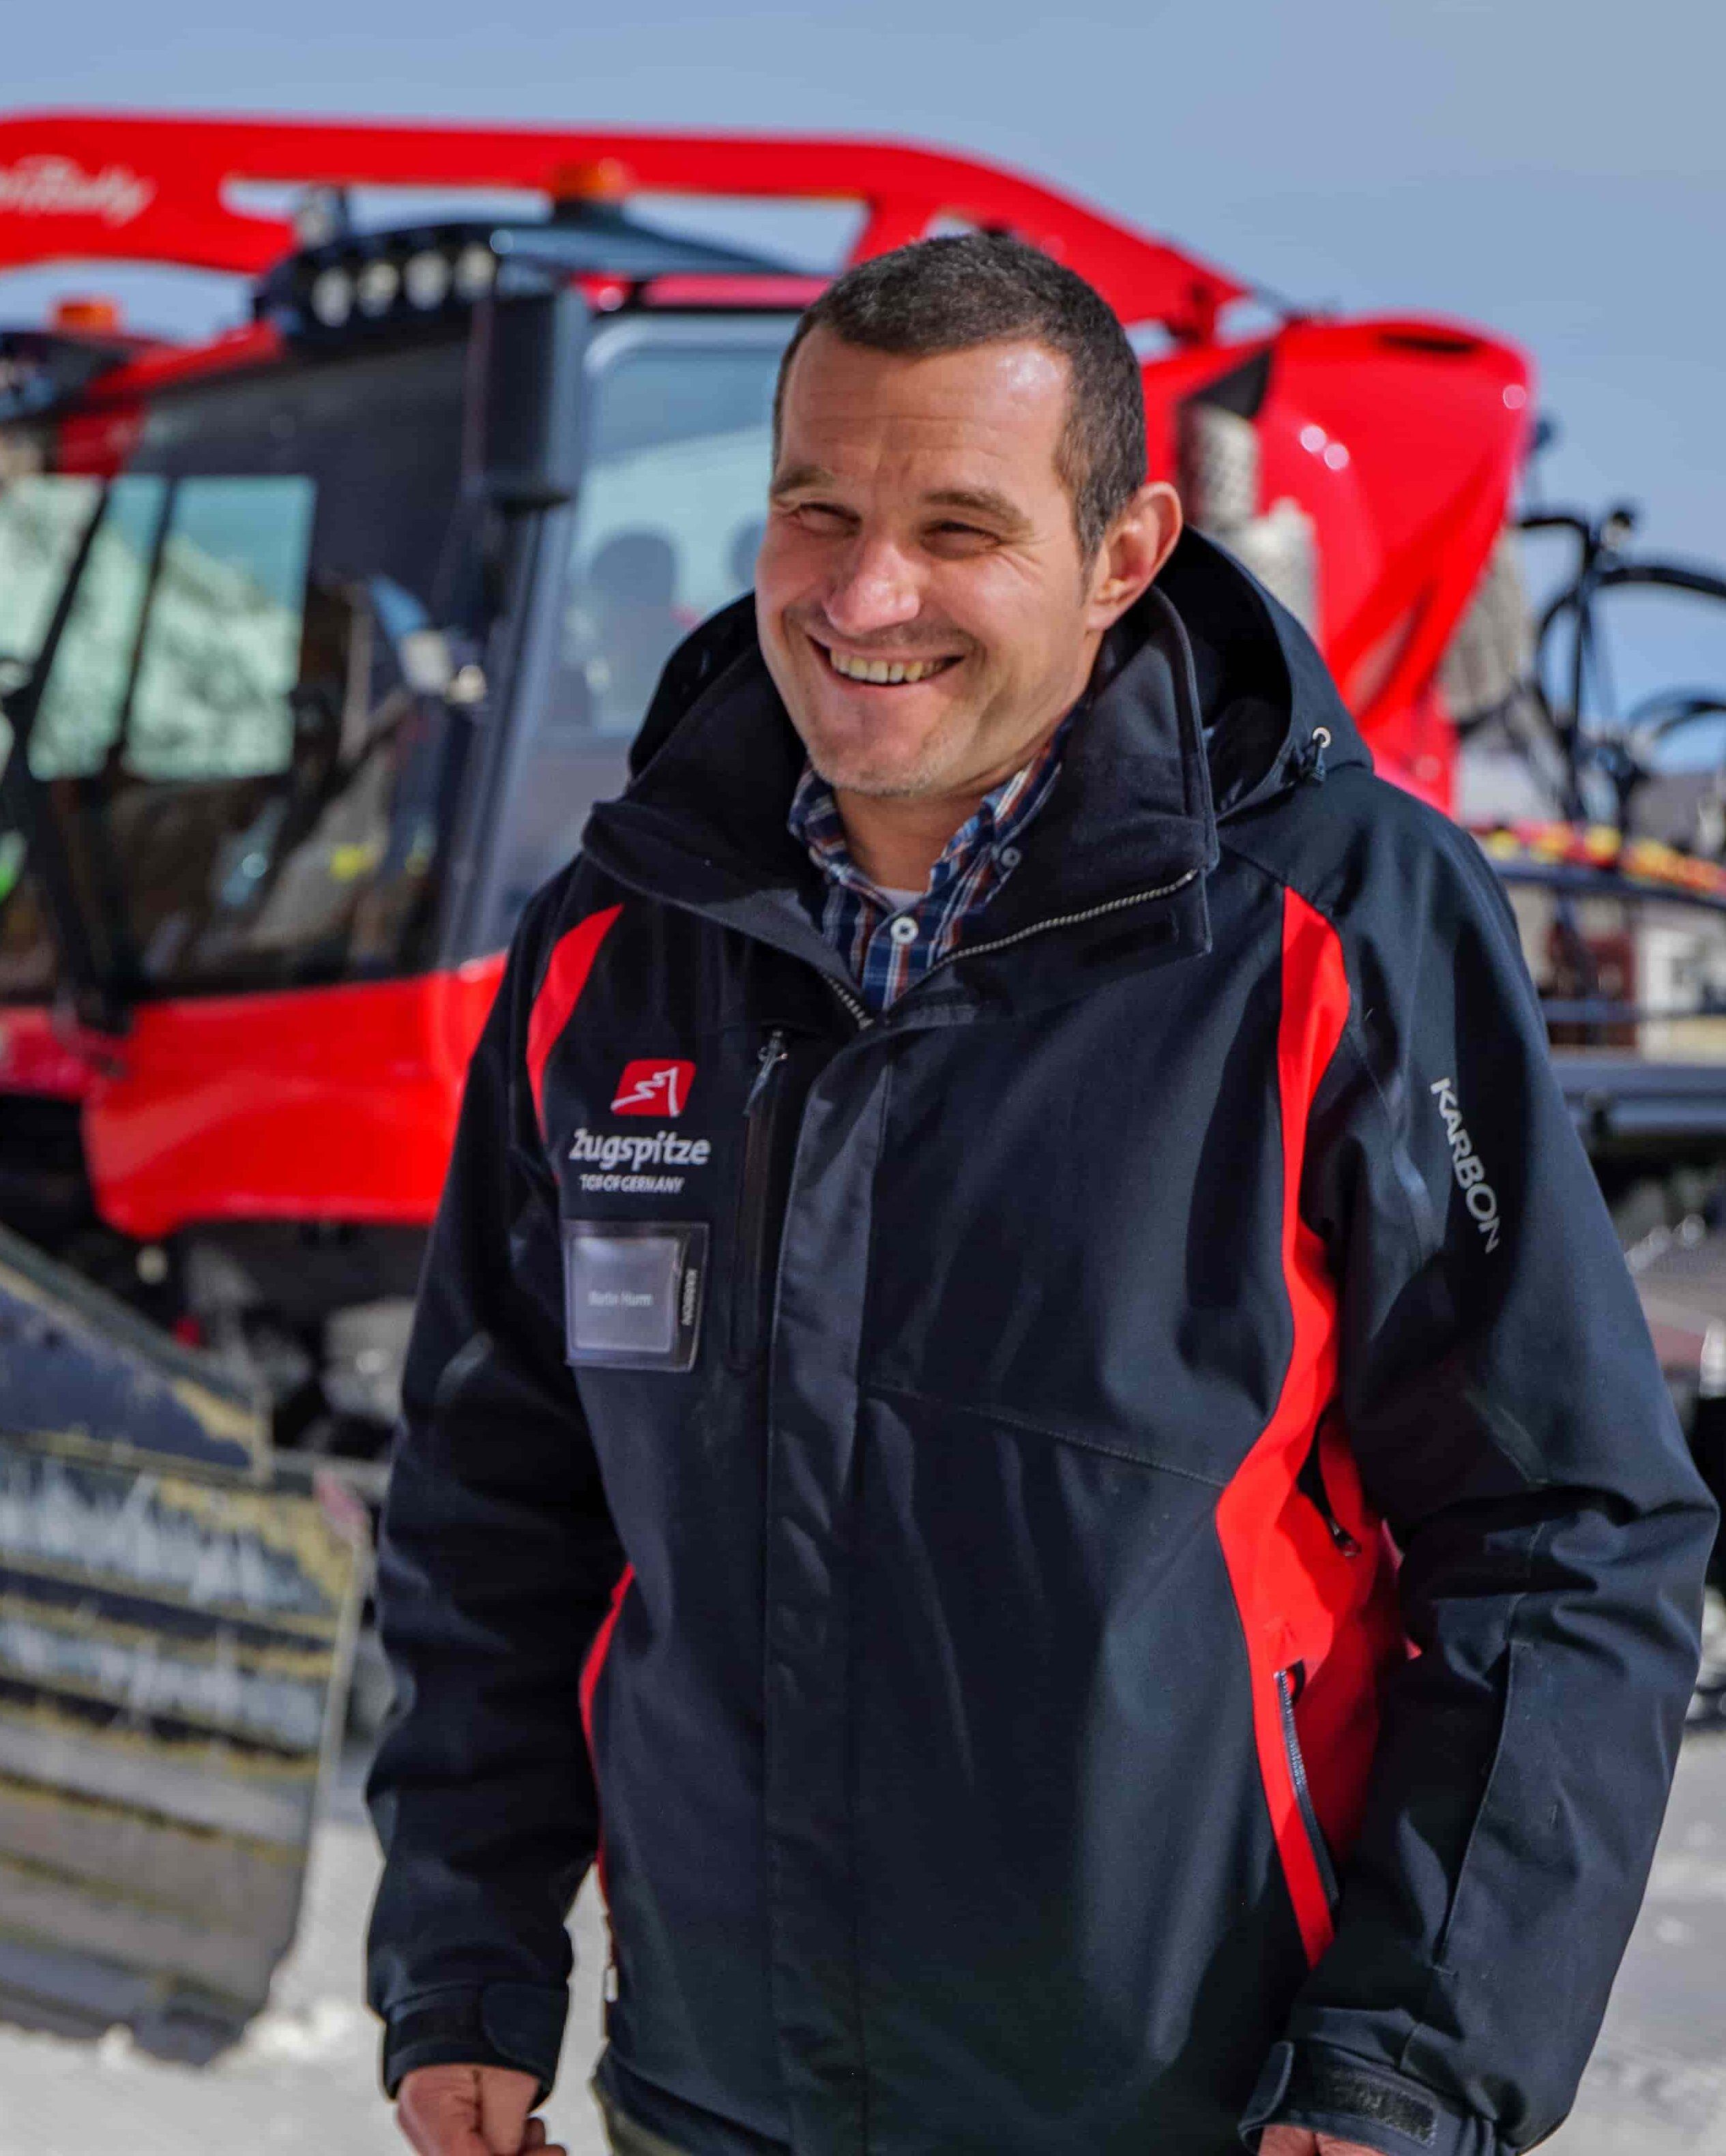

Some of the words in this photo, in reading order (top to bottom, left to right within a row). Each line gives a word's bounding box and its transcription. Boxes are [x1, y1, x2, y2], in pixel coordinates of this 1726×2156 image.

[569, 1127, 712, 1172] Zugspitze
[1430, 1077, 1501, 1254] KARBON
[620, 1175, 685, 1194] GERMANY
